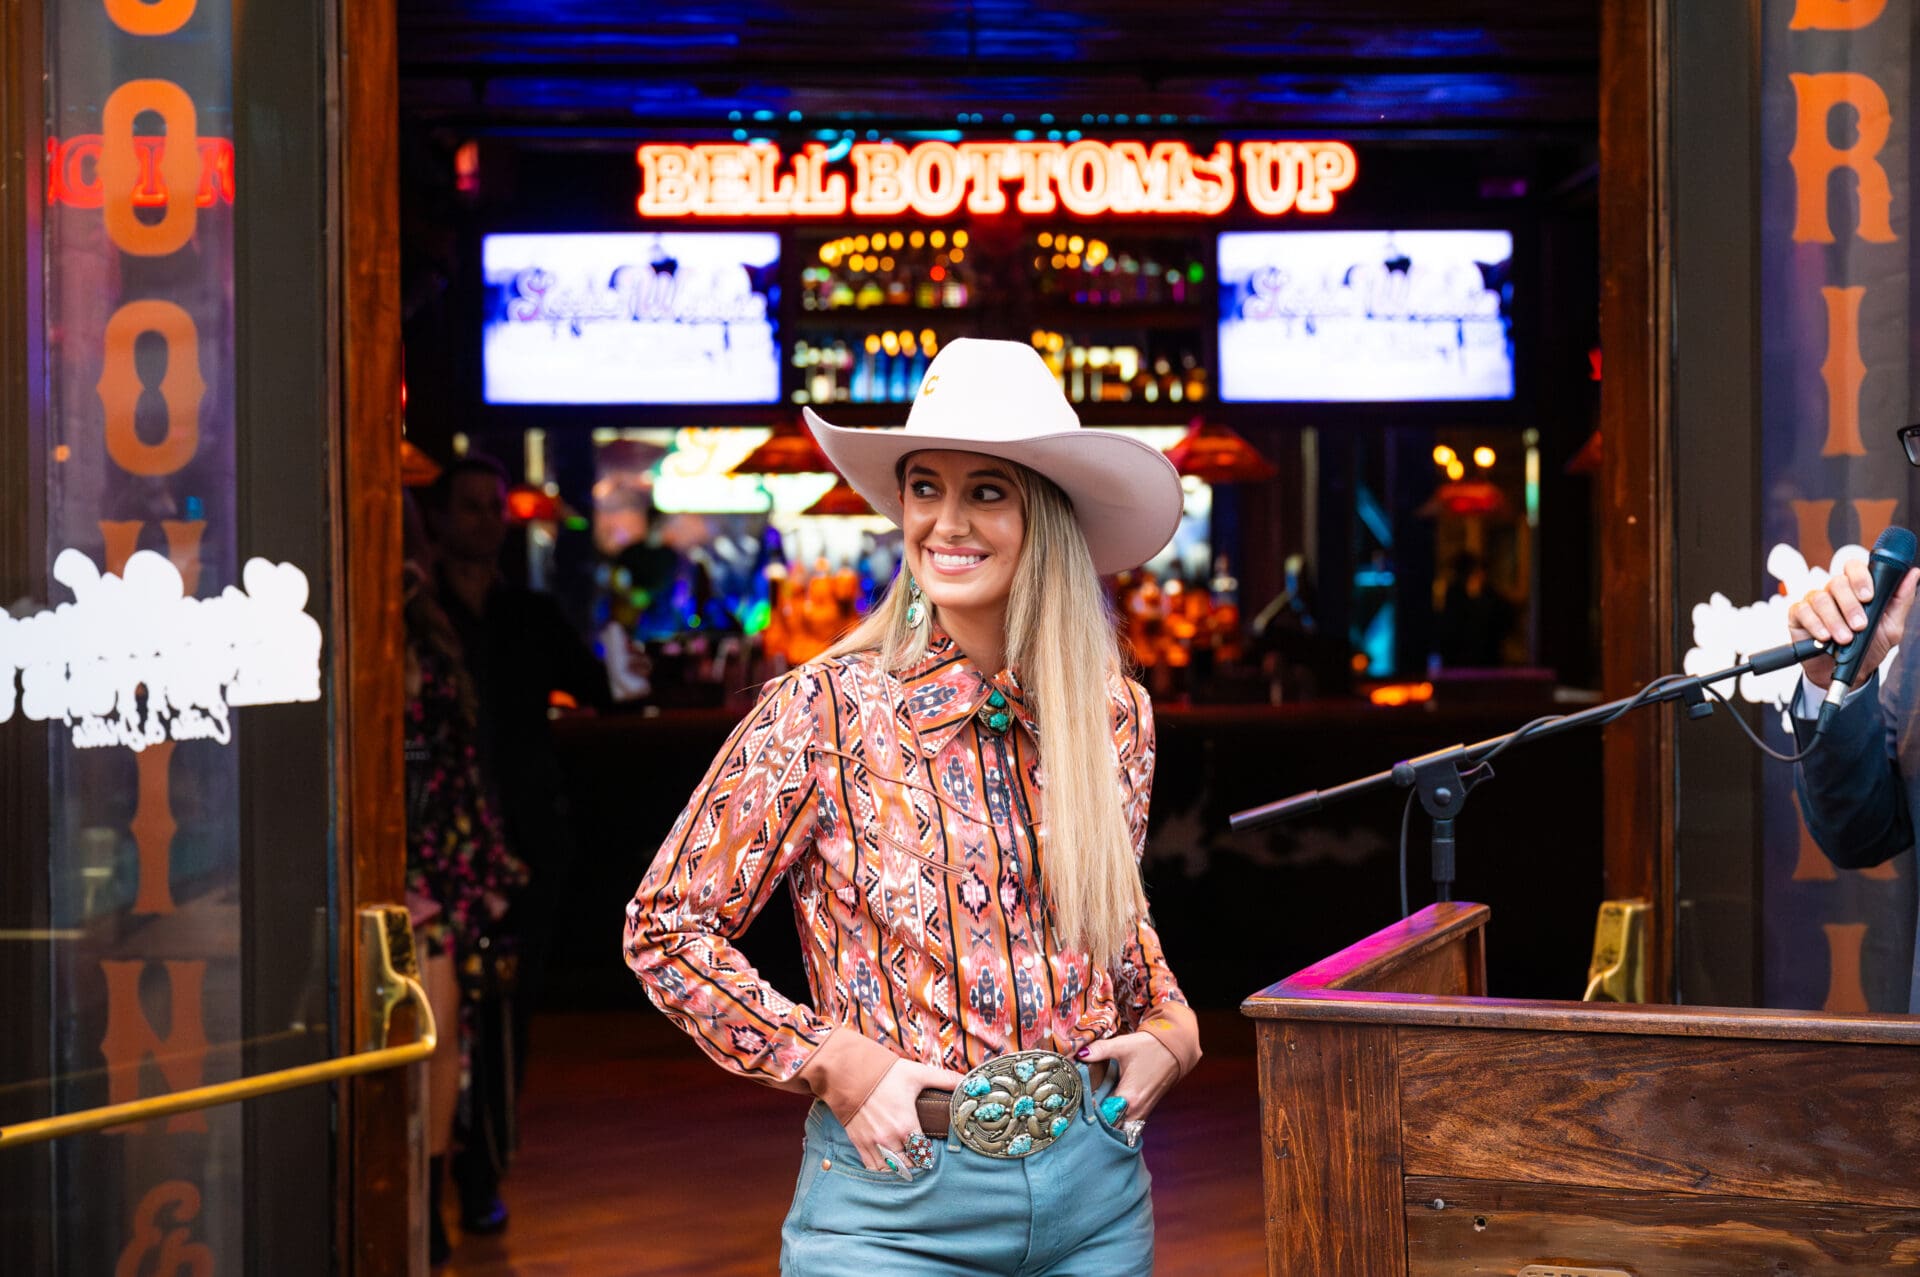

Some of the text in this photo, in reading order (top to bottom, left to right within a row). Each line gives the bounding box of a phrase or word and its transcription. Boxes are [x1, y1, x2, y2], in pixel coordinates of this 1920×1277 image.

[637, 140, 1358, 217] BELL BOTTOMS UP
